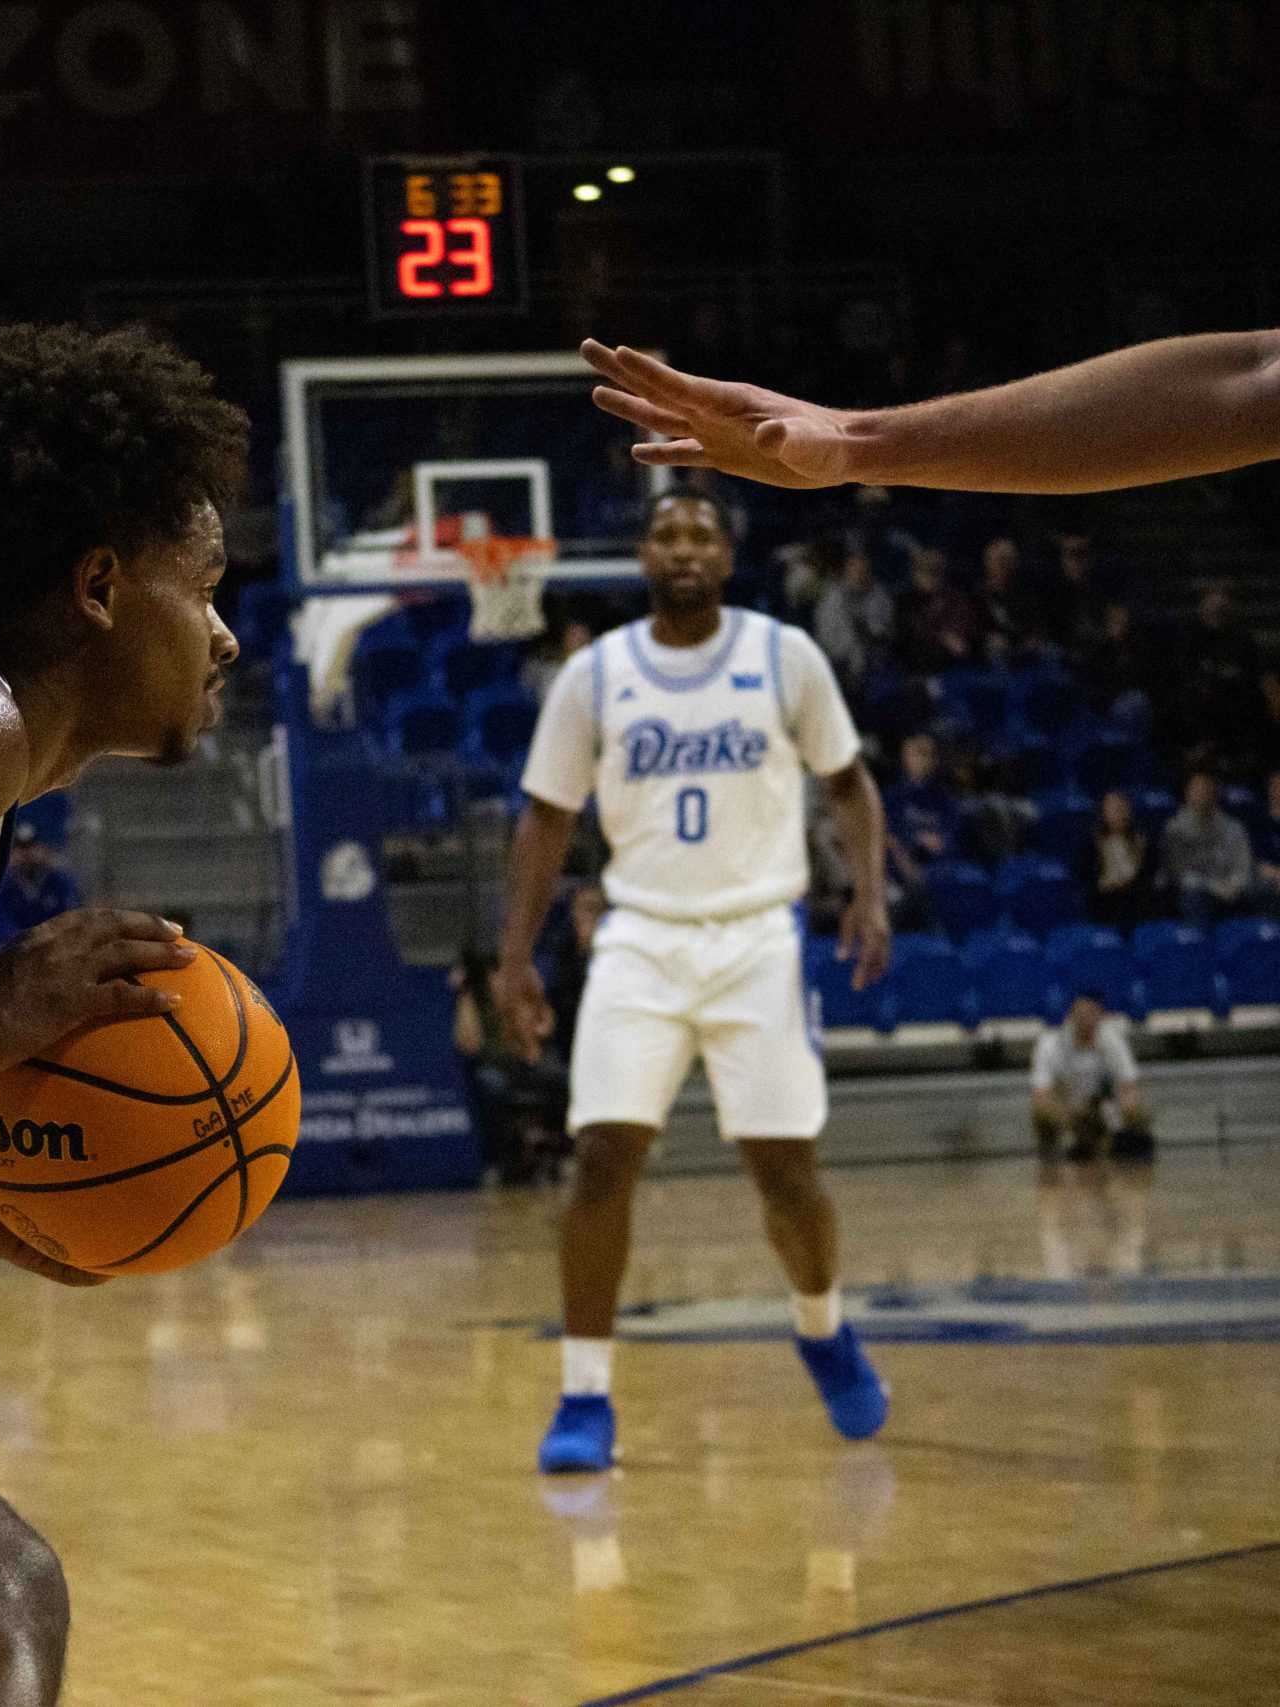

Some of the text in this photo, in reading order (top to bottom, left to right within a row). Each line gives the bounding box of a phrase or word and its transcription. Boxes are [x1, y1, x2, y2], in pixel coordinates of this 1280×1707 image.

[398, 218, 494, 298] 23
[620, 716, 768, 784] Drake
[676, 787, 708, 843] 0
